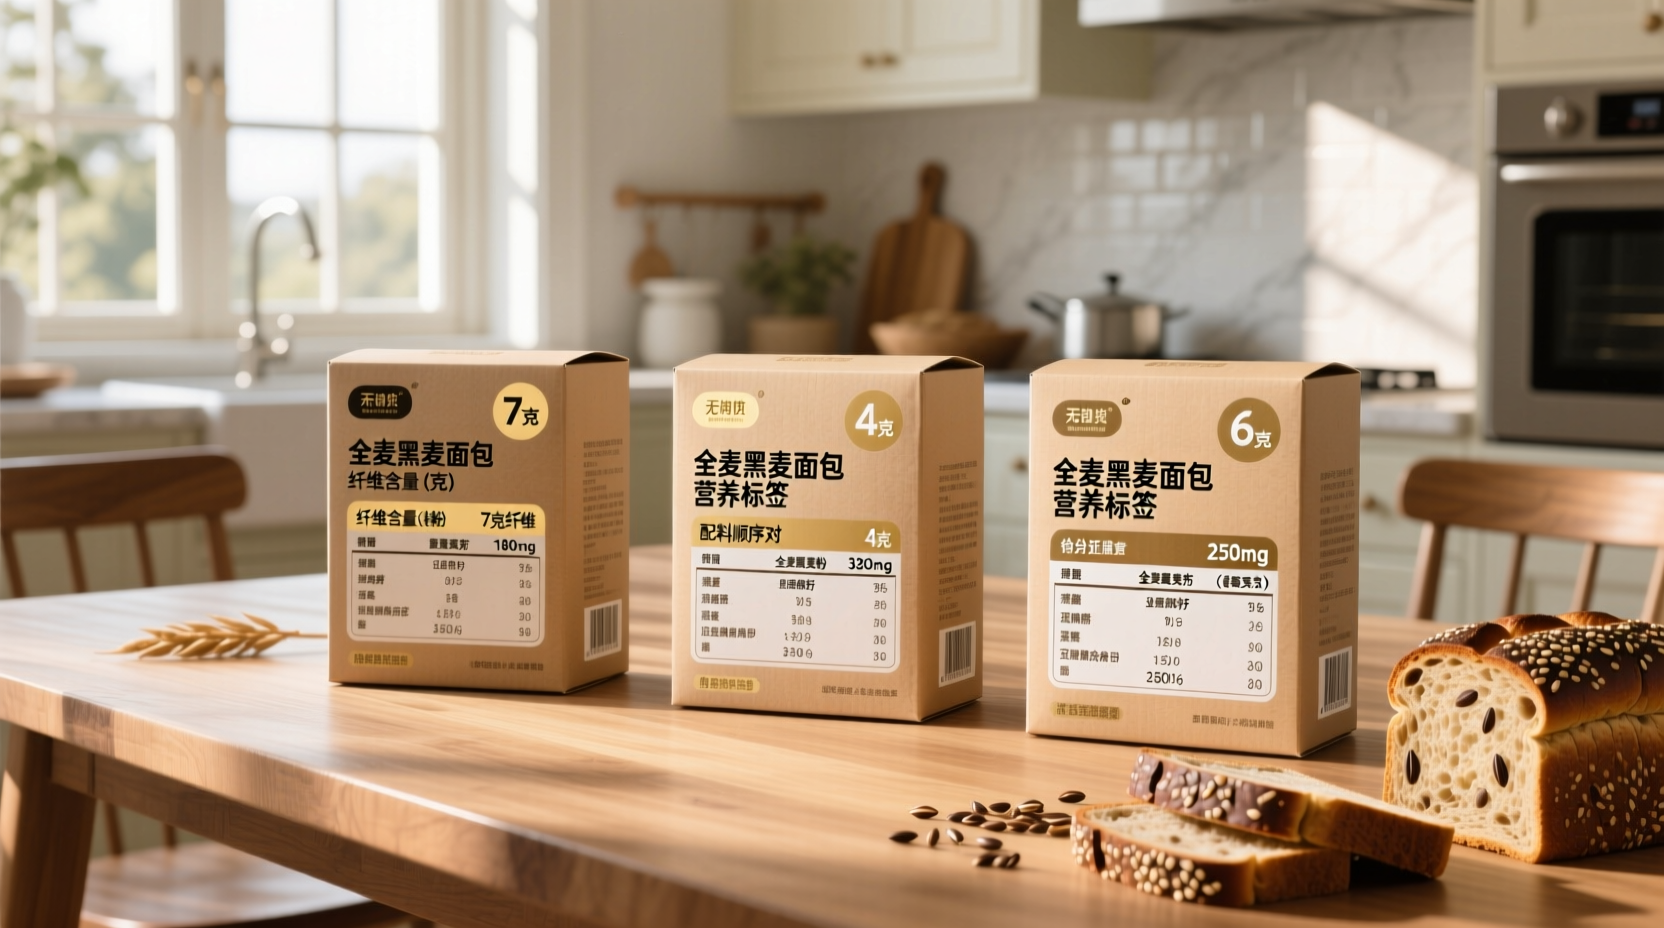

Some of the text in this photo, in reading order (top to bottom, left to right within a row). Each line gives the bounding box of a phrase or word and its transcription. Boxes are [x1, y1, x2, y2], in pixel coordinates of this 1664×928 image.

[503, 396, 539, 426] 7克
[855, 403, 894, 437] 4克
[1230, 410, 1272, 449] 6克
[348, 438, 494, 468] 全麦黑麦面包
[694, 448, 844, 480] 全麦黑麦面包
[1053, 457, 1214, 491] 全麦黑麦面包
[694, 479, 789, 508] 营养标签
[1053, 488, 1157, 519] 营养标签
[699, 522, 892, 548] 配料顺序对 4克
[1207, 543, 1269, 567] 250mg
